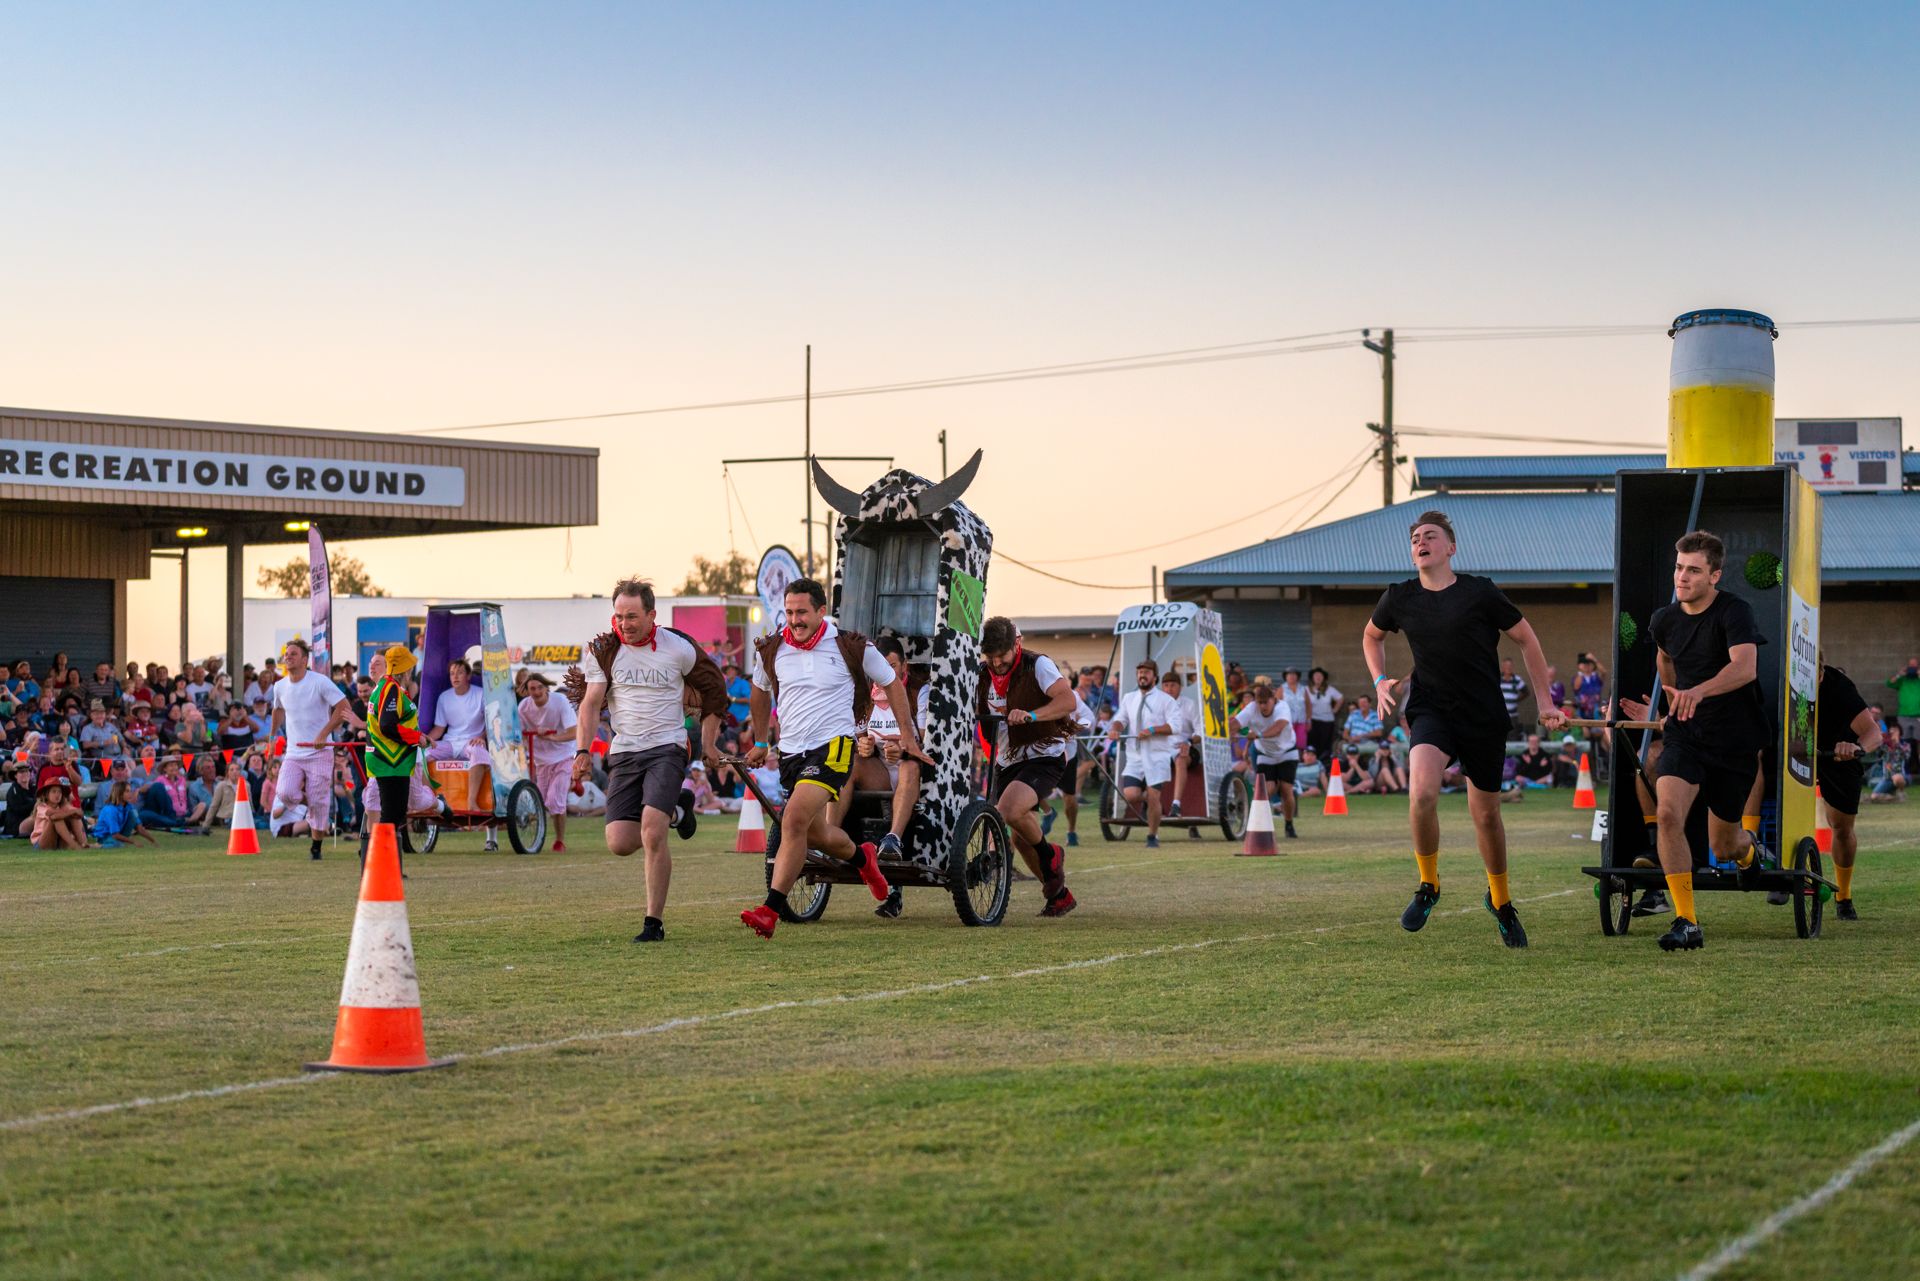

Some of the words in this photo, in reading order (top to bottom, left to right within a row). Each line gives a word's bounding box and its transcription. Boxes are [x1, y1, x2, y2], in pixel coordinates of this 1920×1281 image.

[1774, 451, 1805, 460] EVILS
[1849, 450, 1896, 460] VISITORS
[0, 449, 248, 487] RECREATION
[266, 464, 426, 497] GROUND
[1791, 619, 1816, 666] Corona
[533, 645, 581, 662] MOBILE
[614, 669, 669, 684] CALVIN
